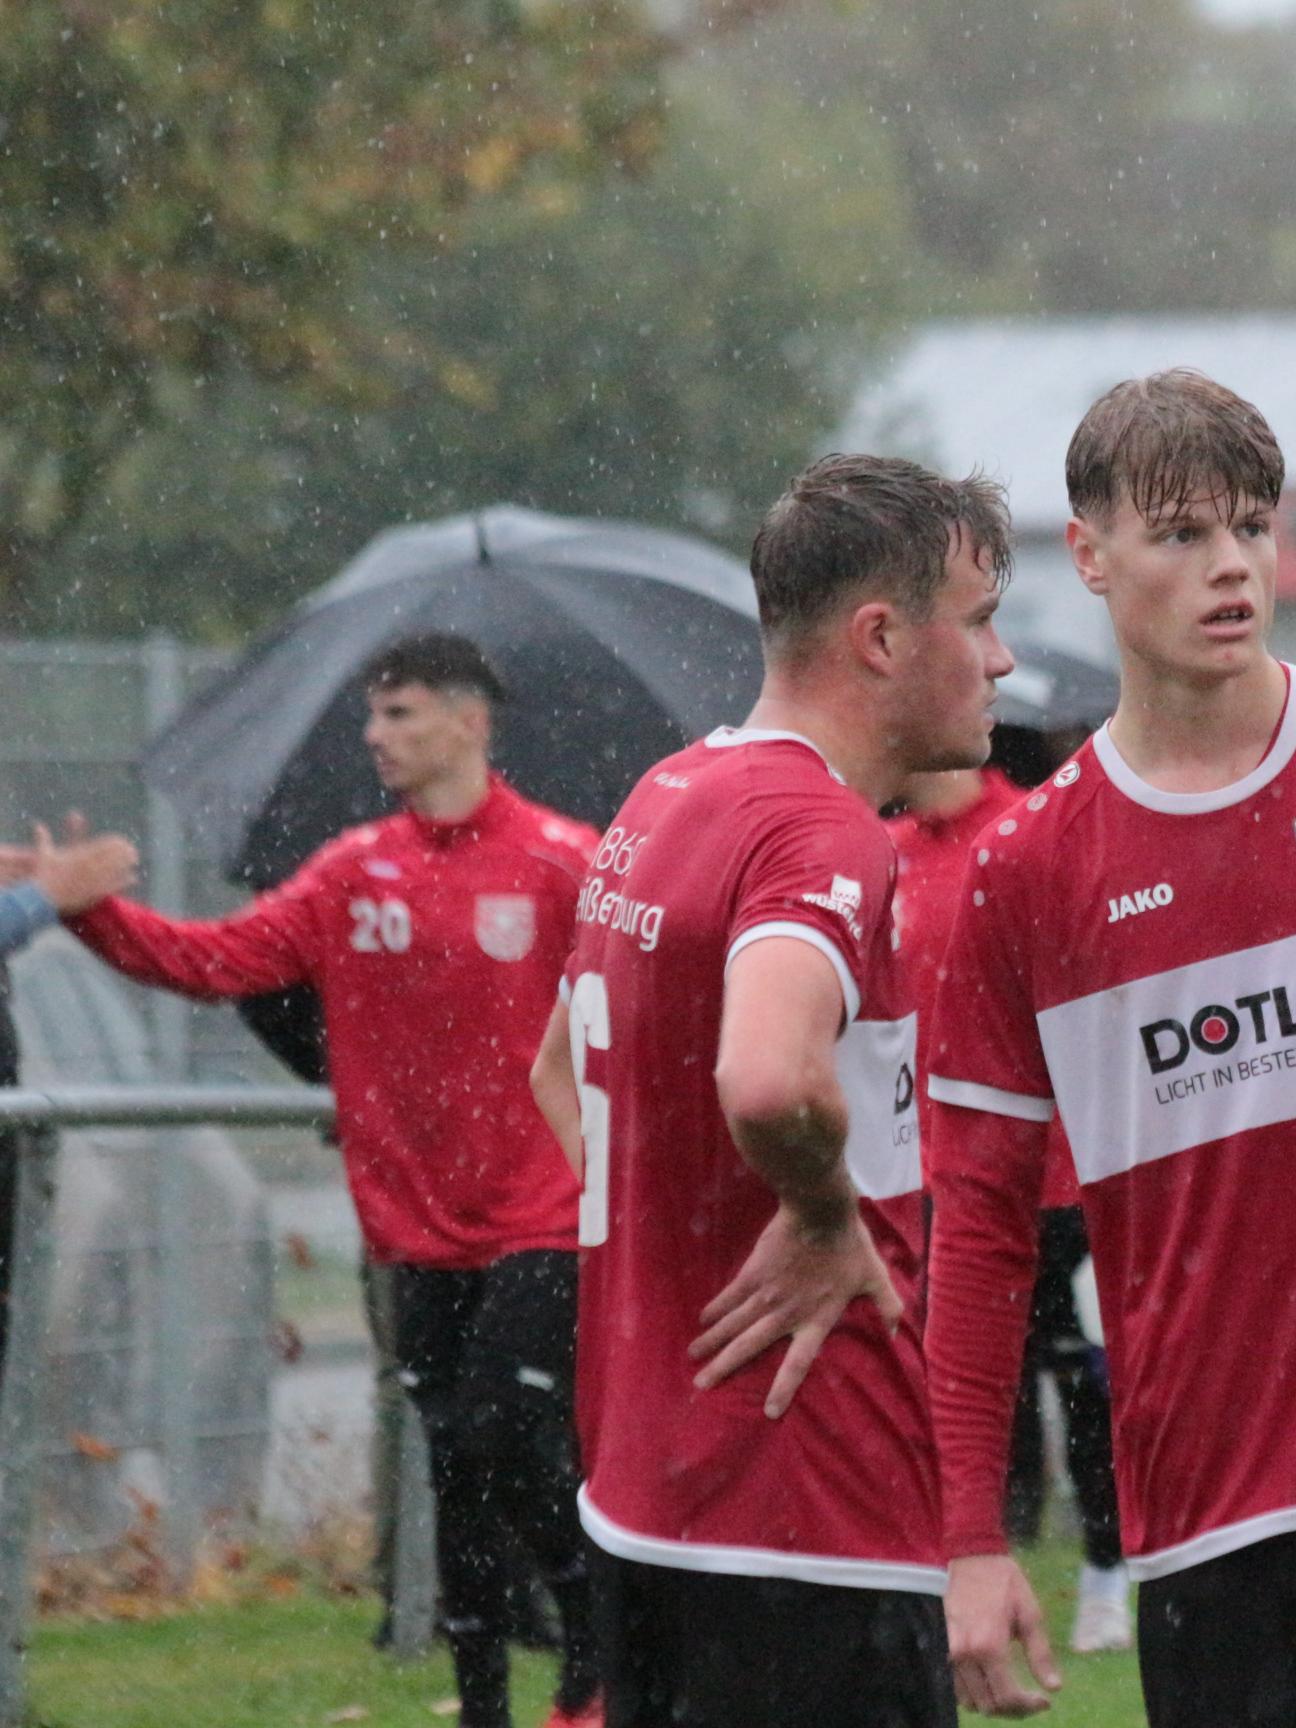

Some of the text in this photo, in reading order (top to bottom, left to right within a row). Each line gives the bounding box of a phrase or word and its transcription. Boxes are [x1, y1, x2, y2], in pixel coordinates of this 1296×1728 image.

[1107, 882, 1174, 924] JAKO
[348, 897, 412, 952] 20
[1154, 1072, 1206, 1105] LICHT
[1211, 1065, 1234, 1089] IN
